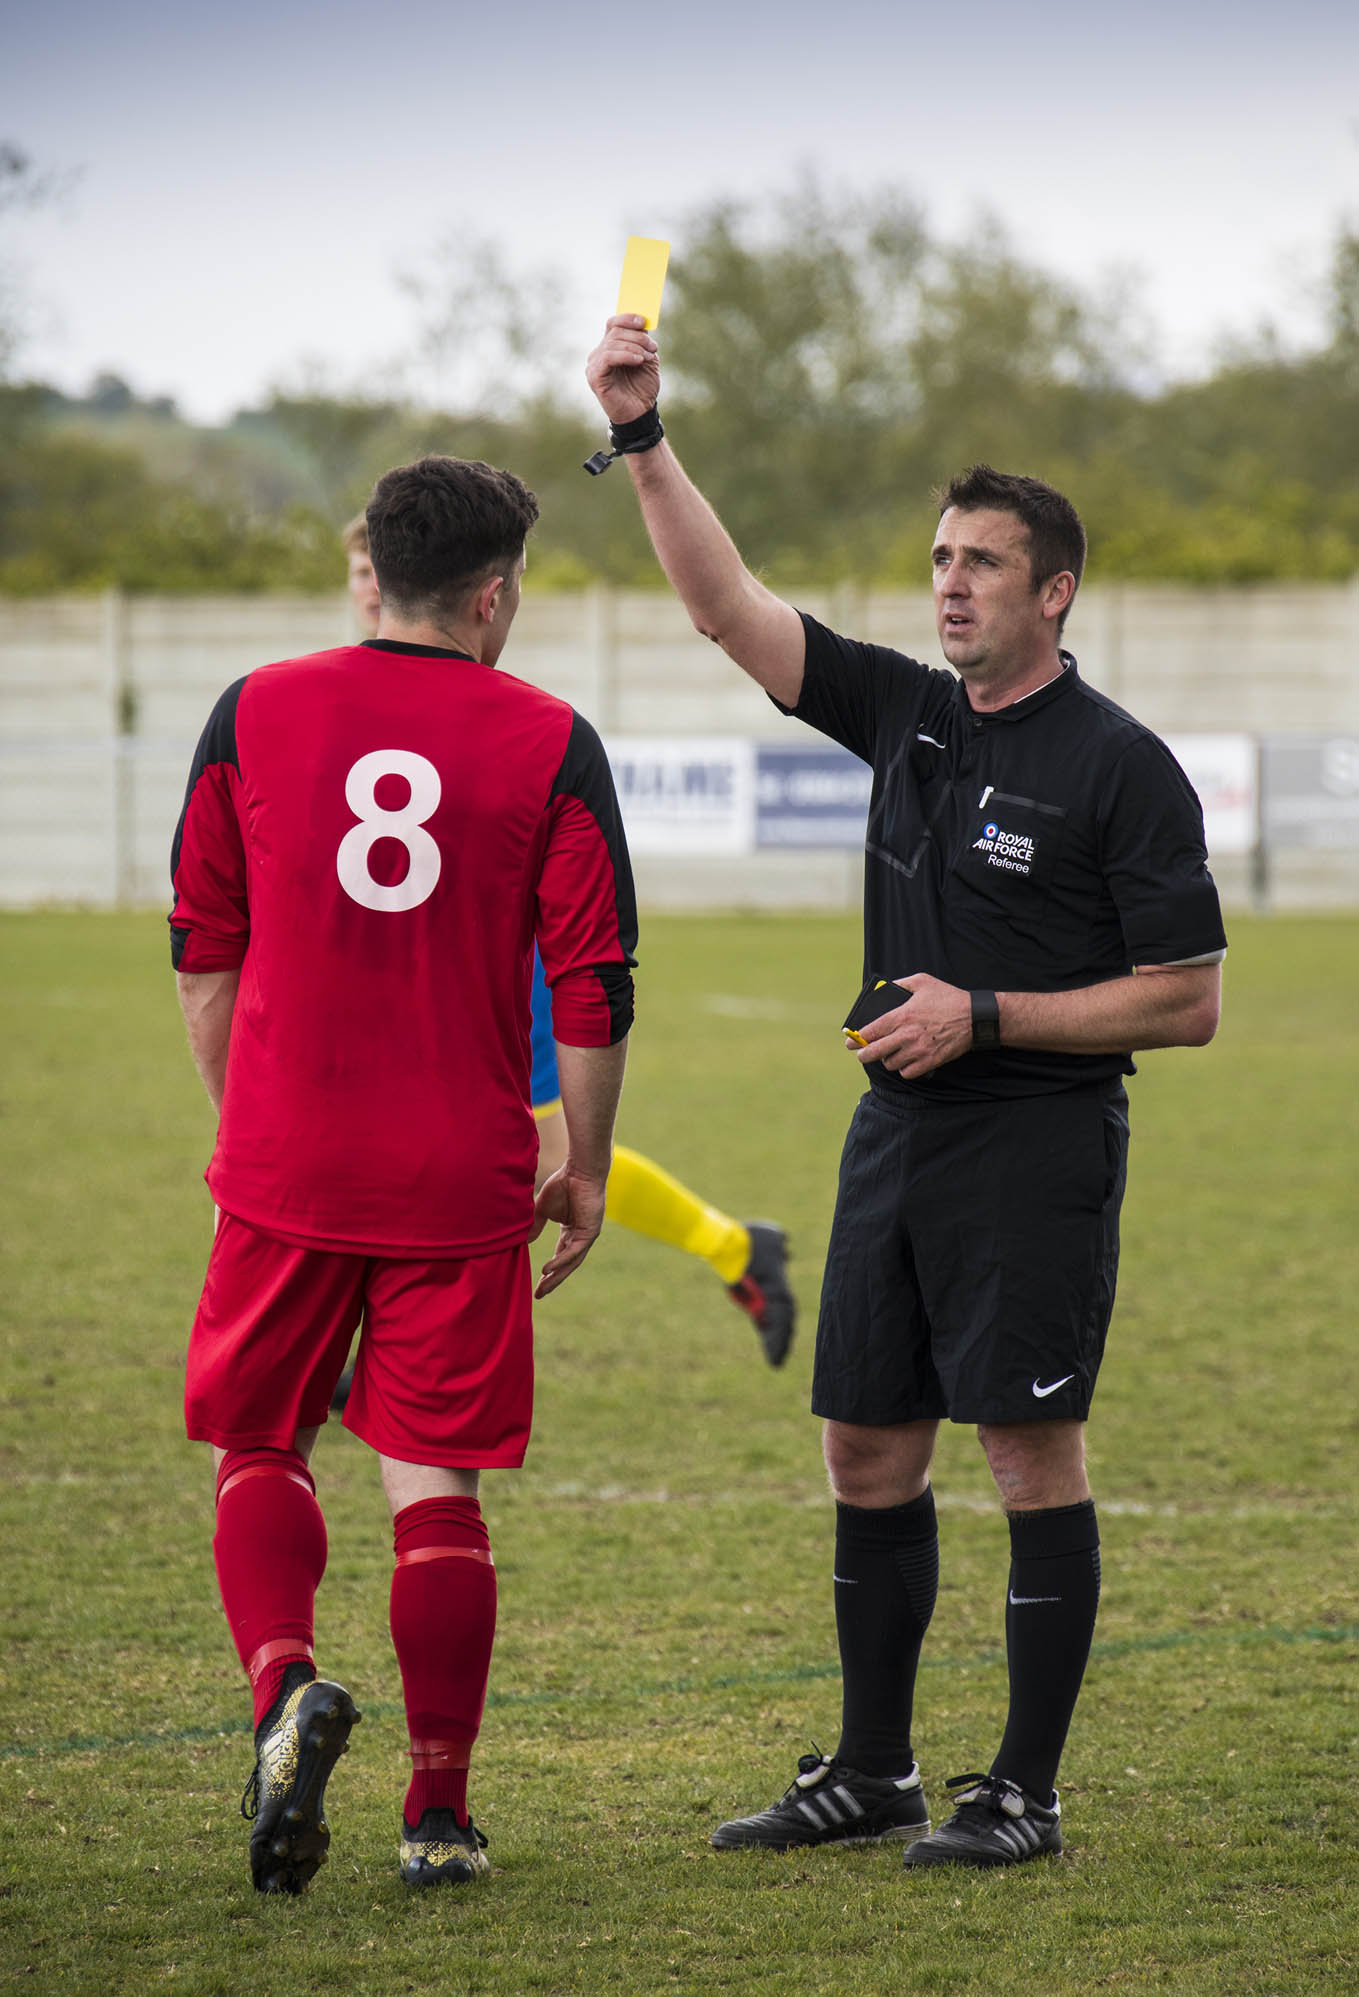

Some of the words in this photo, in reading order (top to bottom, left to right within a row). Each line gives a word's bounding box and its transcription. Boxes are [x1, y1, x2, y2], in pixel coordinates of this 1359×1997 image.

[337, 749, 442, 912] 8
[997, 831, 1035, 851] ROYAL
[972, 838, 994, 852] AIR
[993, 842, 1034, 861] FORCE
[987, 854, 1030, 874] Referee
